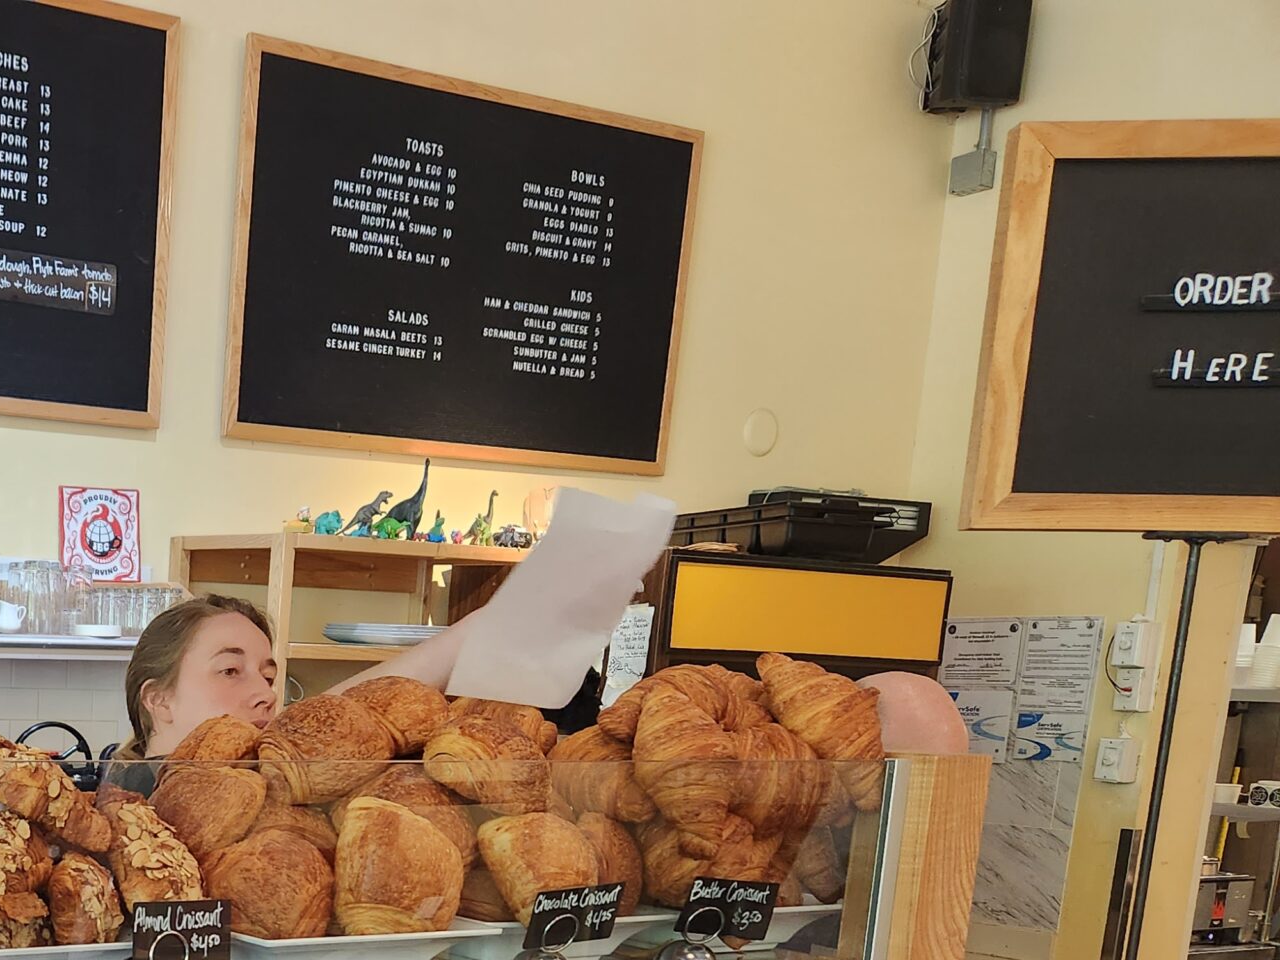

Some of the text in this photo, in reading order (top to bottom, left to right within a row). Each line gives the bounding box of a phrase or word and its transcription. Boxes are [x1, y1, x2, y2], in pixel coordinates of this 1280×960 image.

[0, 113, 28, 130] BEEF
[405, 137, 444, 158] TOASTS
[371, 153, 443, 177] AVOCADO & EGG
[0, 168, 29, 185] MEOW
[570, 169, 605, 188] BOWLS
[570, 289, 593, 304] KIDS
[1174, 272, 1274, 307] ORDER
[387, 309, 429, 326] SALADS
[325, 338, 427, 360] SESAME GINGER TURKEY
[83, 494, 118, 505] PROUDLY
[534, 885, 622, 914] Chocolate Croissant
[689, 879, 770, 904] Butter Croissant
[133, 901, 223, 933] Almond Croissant
